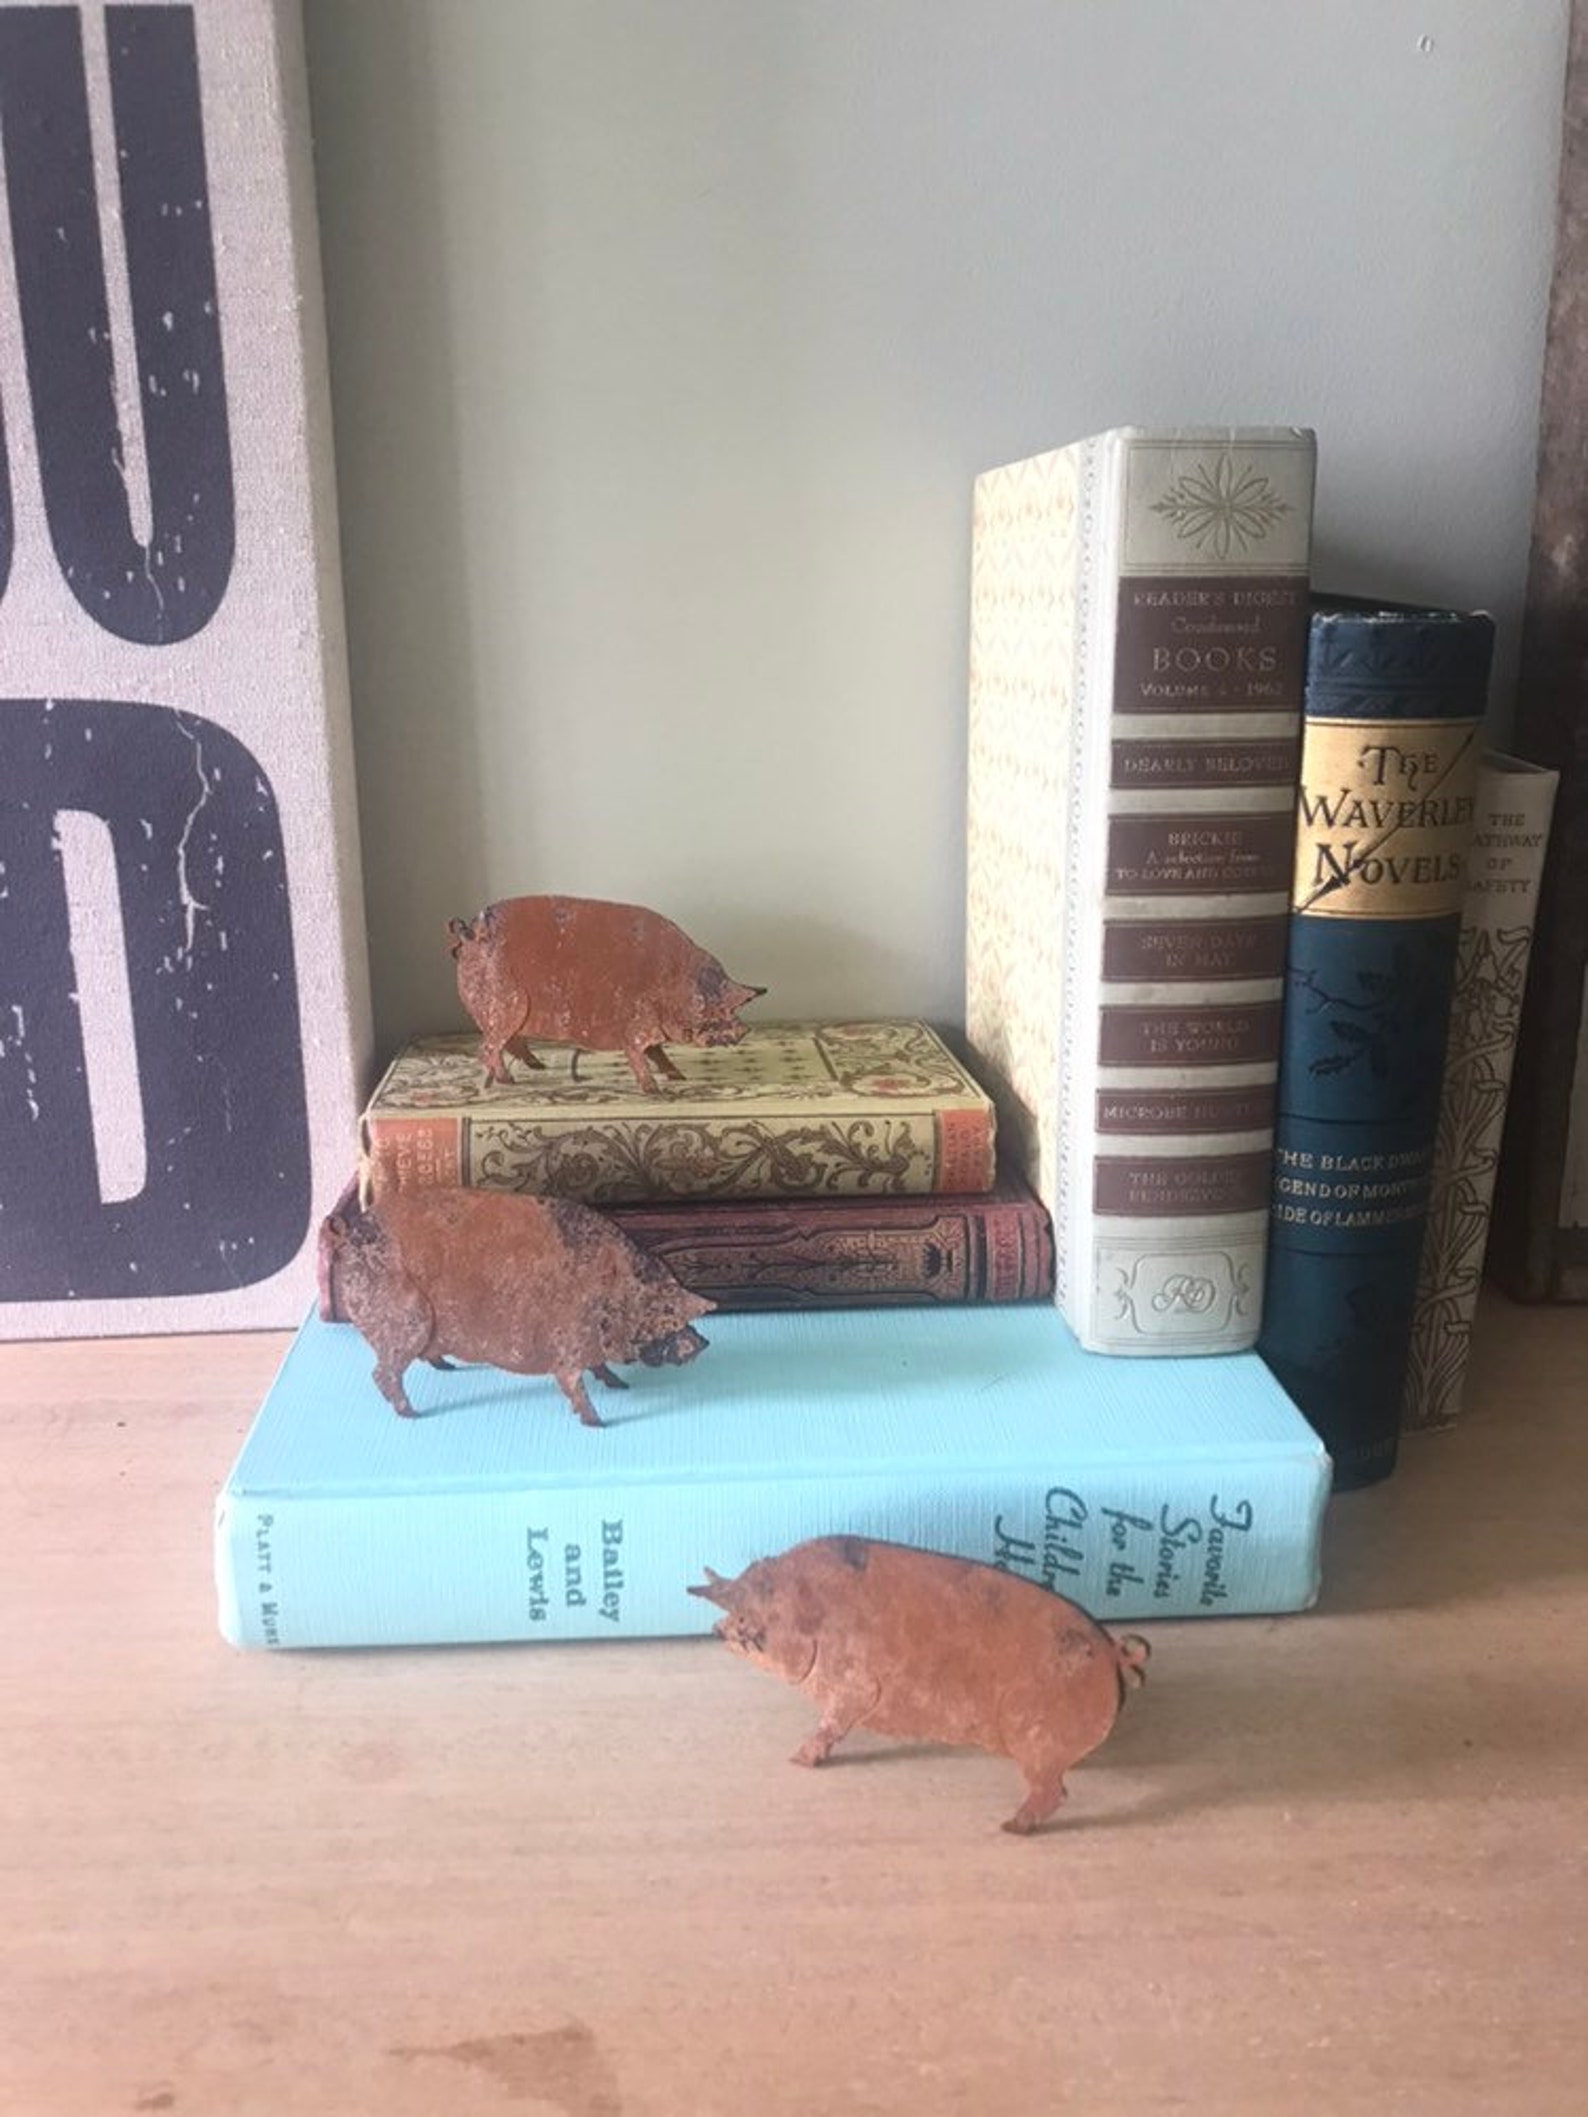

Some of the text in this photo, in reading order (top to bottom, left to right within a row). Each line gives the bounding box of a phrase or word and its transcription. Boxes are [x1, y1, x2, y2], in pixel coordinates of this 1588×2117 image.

[1152, 645, 1278, 672] BOOKS
[1140, 681, 1211, 697] VOLUME
[1123, 757, 1196, 773] DEARLY
[1300, 784, 1475, 829] WAVERLE
[1488, 812, 1526, 826] THE
[1470, 833, 1542, 848] ATHWAY
[1144, 850, 1158, 864] A
[1320, 1153, 1386, 1172] BLACK
[1101, 1506, 1154, 1598] for the
[1153, 1503, 1202, 1599] Stories
[526, 1526, 551, 1623] Lewis
[564, 1542, 588, 1609] and
[600, 1518, 624, 1624] Bailey
